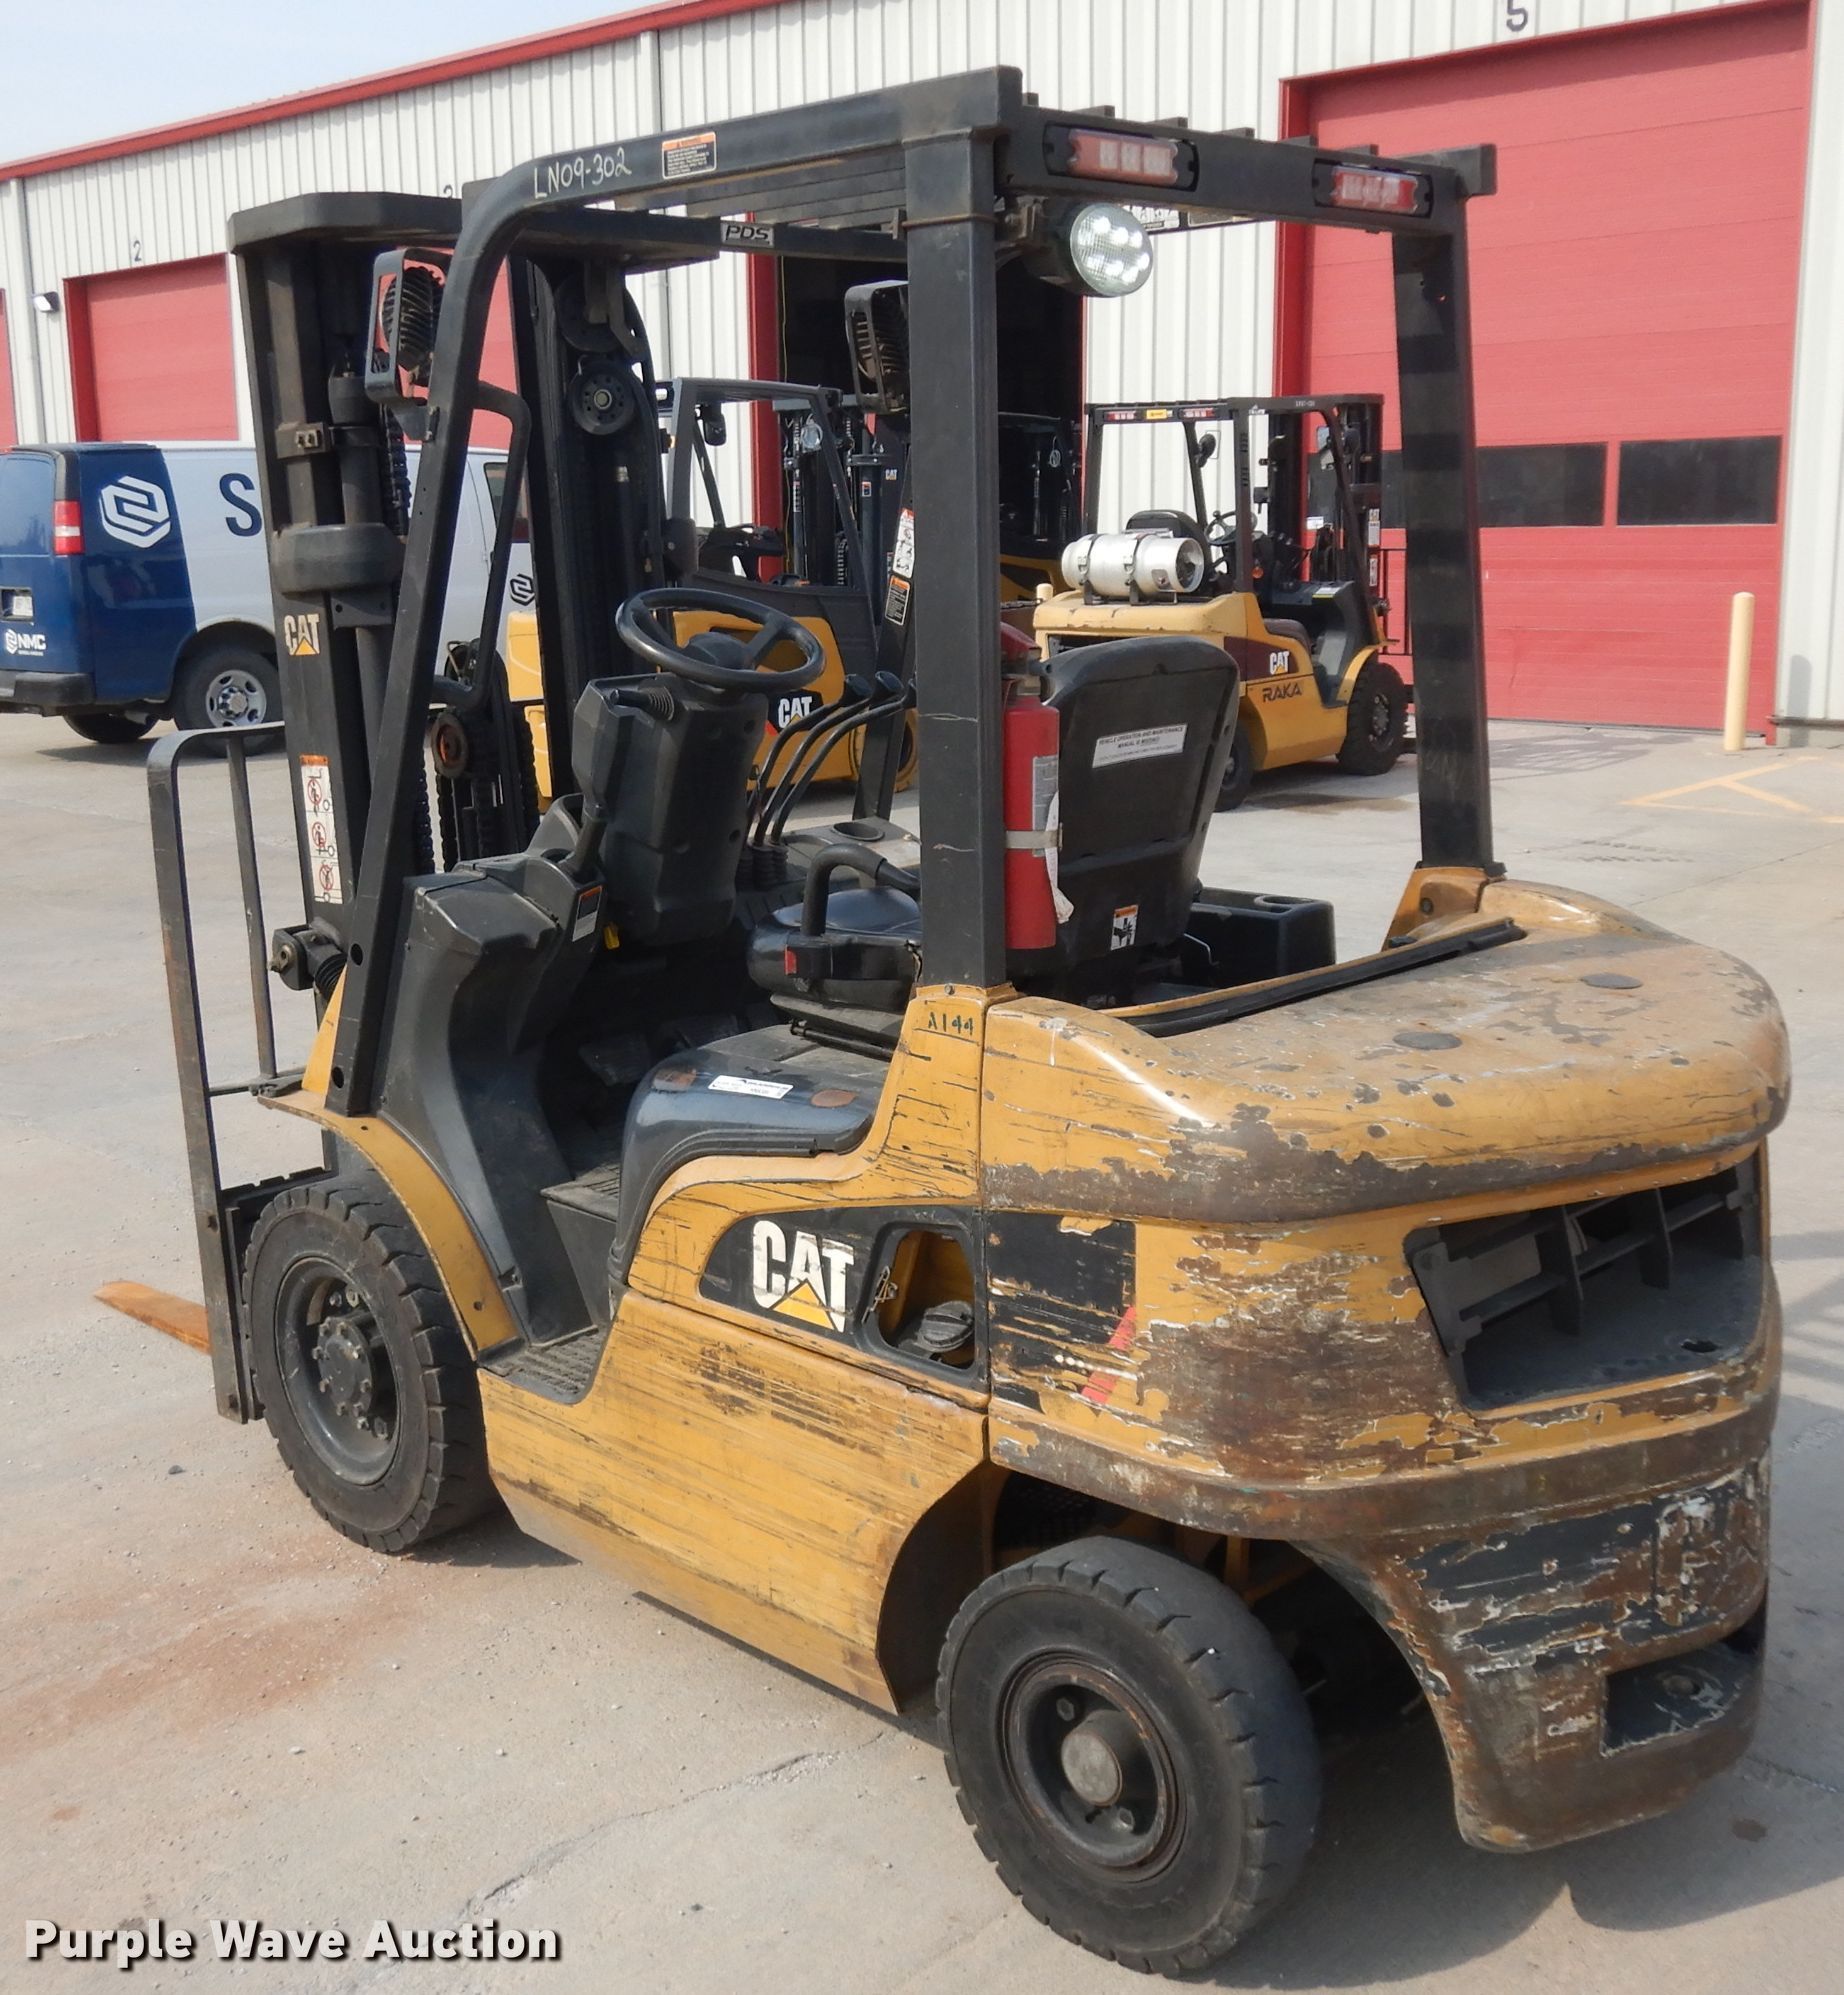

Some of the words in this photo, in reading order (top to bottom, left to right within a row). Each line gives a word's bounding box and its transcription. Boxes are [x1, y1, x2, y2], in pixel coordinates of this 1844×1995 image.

[1506, 0, 1528, 32] 5
[533, 146, 632, 199] LN09-302
[725, 225, 770, 241] PDS
[133, 239, 142, 262] 2
[17, 633, 47, 650] NMC
[284, 613, 320, 656] CAT
[1269, 651, 1290, 675] CAT
[1262, 682, 1303, 702] RAKA
[778, 696, 813, 729] CAT
[753, 1220, 854, 1333] CAT
